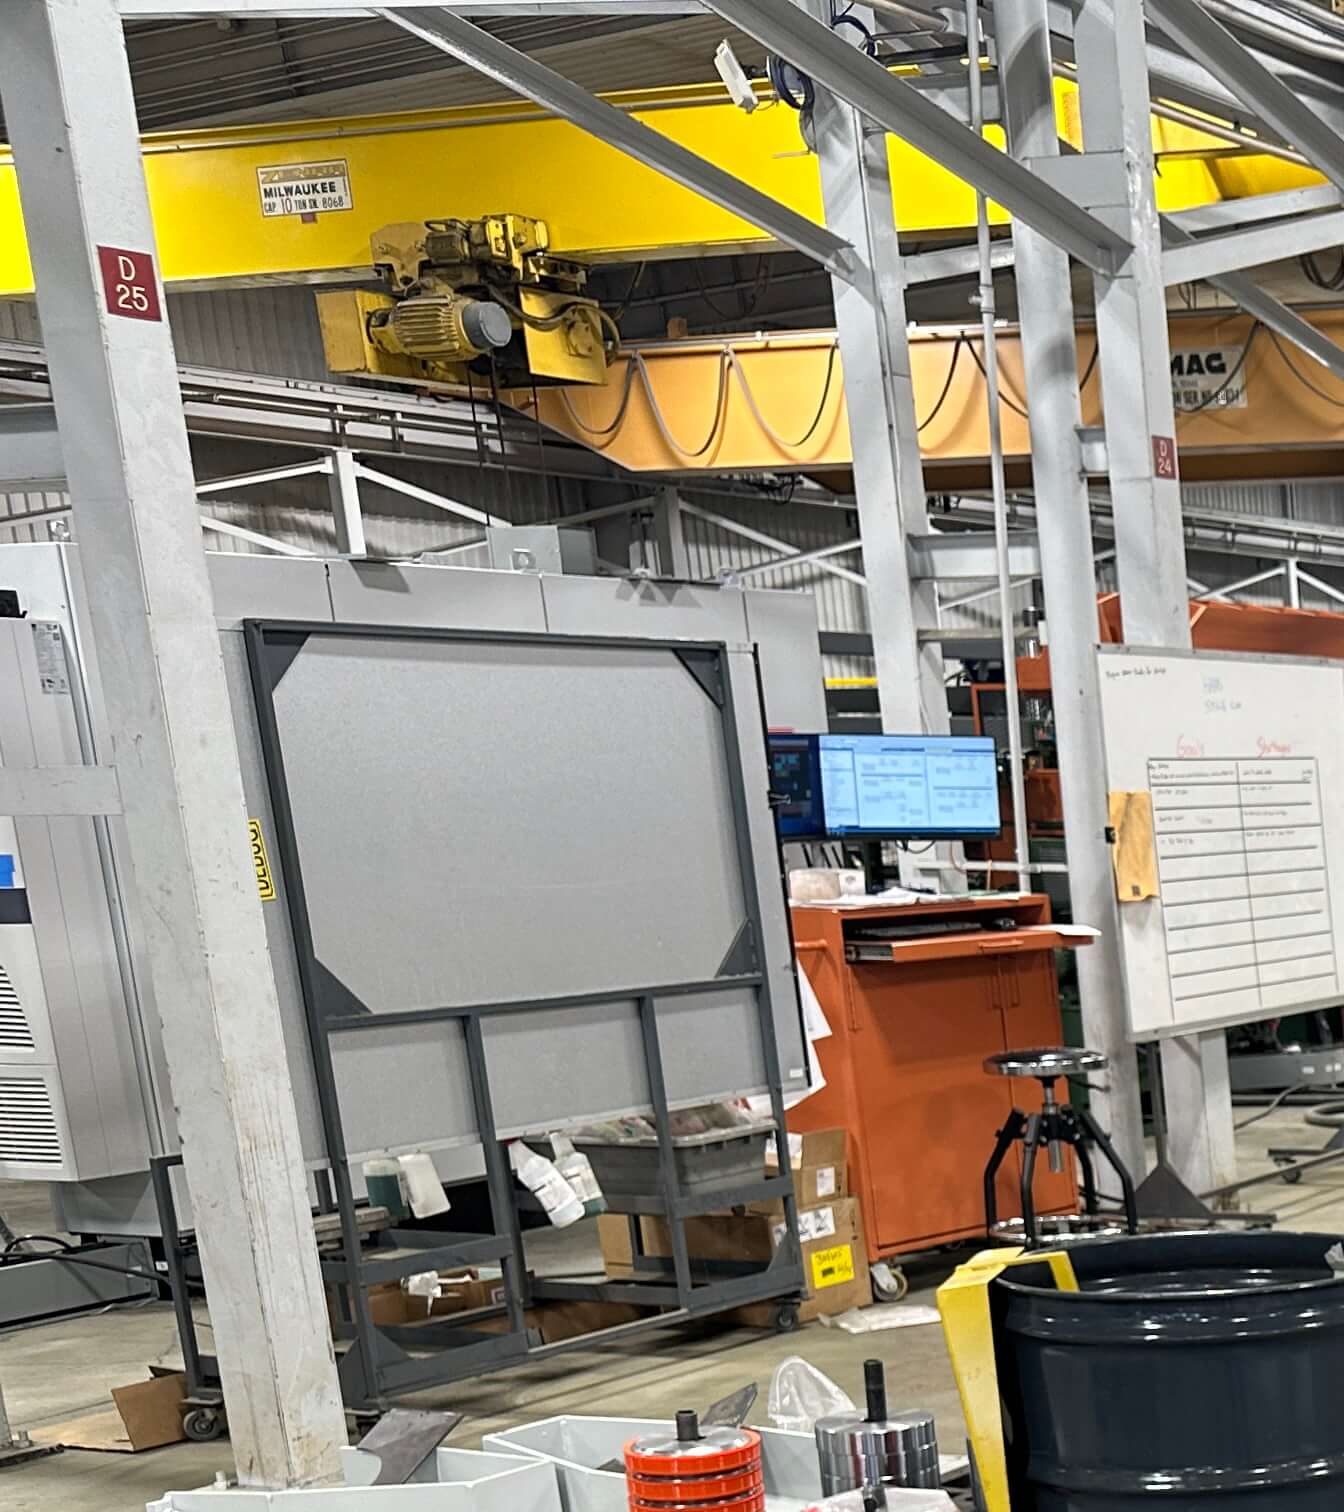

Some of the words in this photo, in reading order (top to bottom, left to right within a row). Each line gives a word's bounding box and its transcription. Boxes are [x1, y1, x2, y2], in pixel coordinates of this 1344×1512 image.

[263, 181, 337, 199] MILWAUKEE
[118, 255, 136, 281] D
[115, 283, 149, 311] 25
[1170, 352, 1226, 376] MAG
